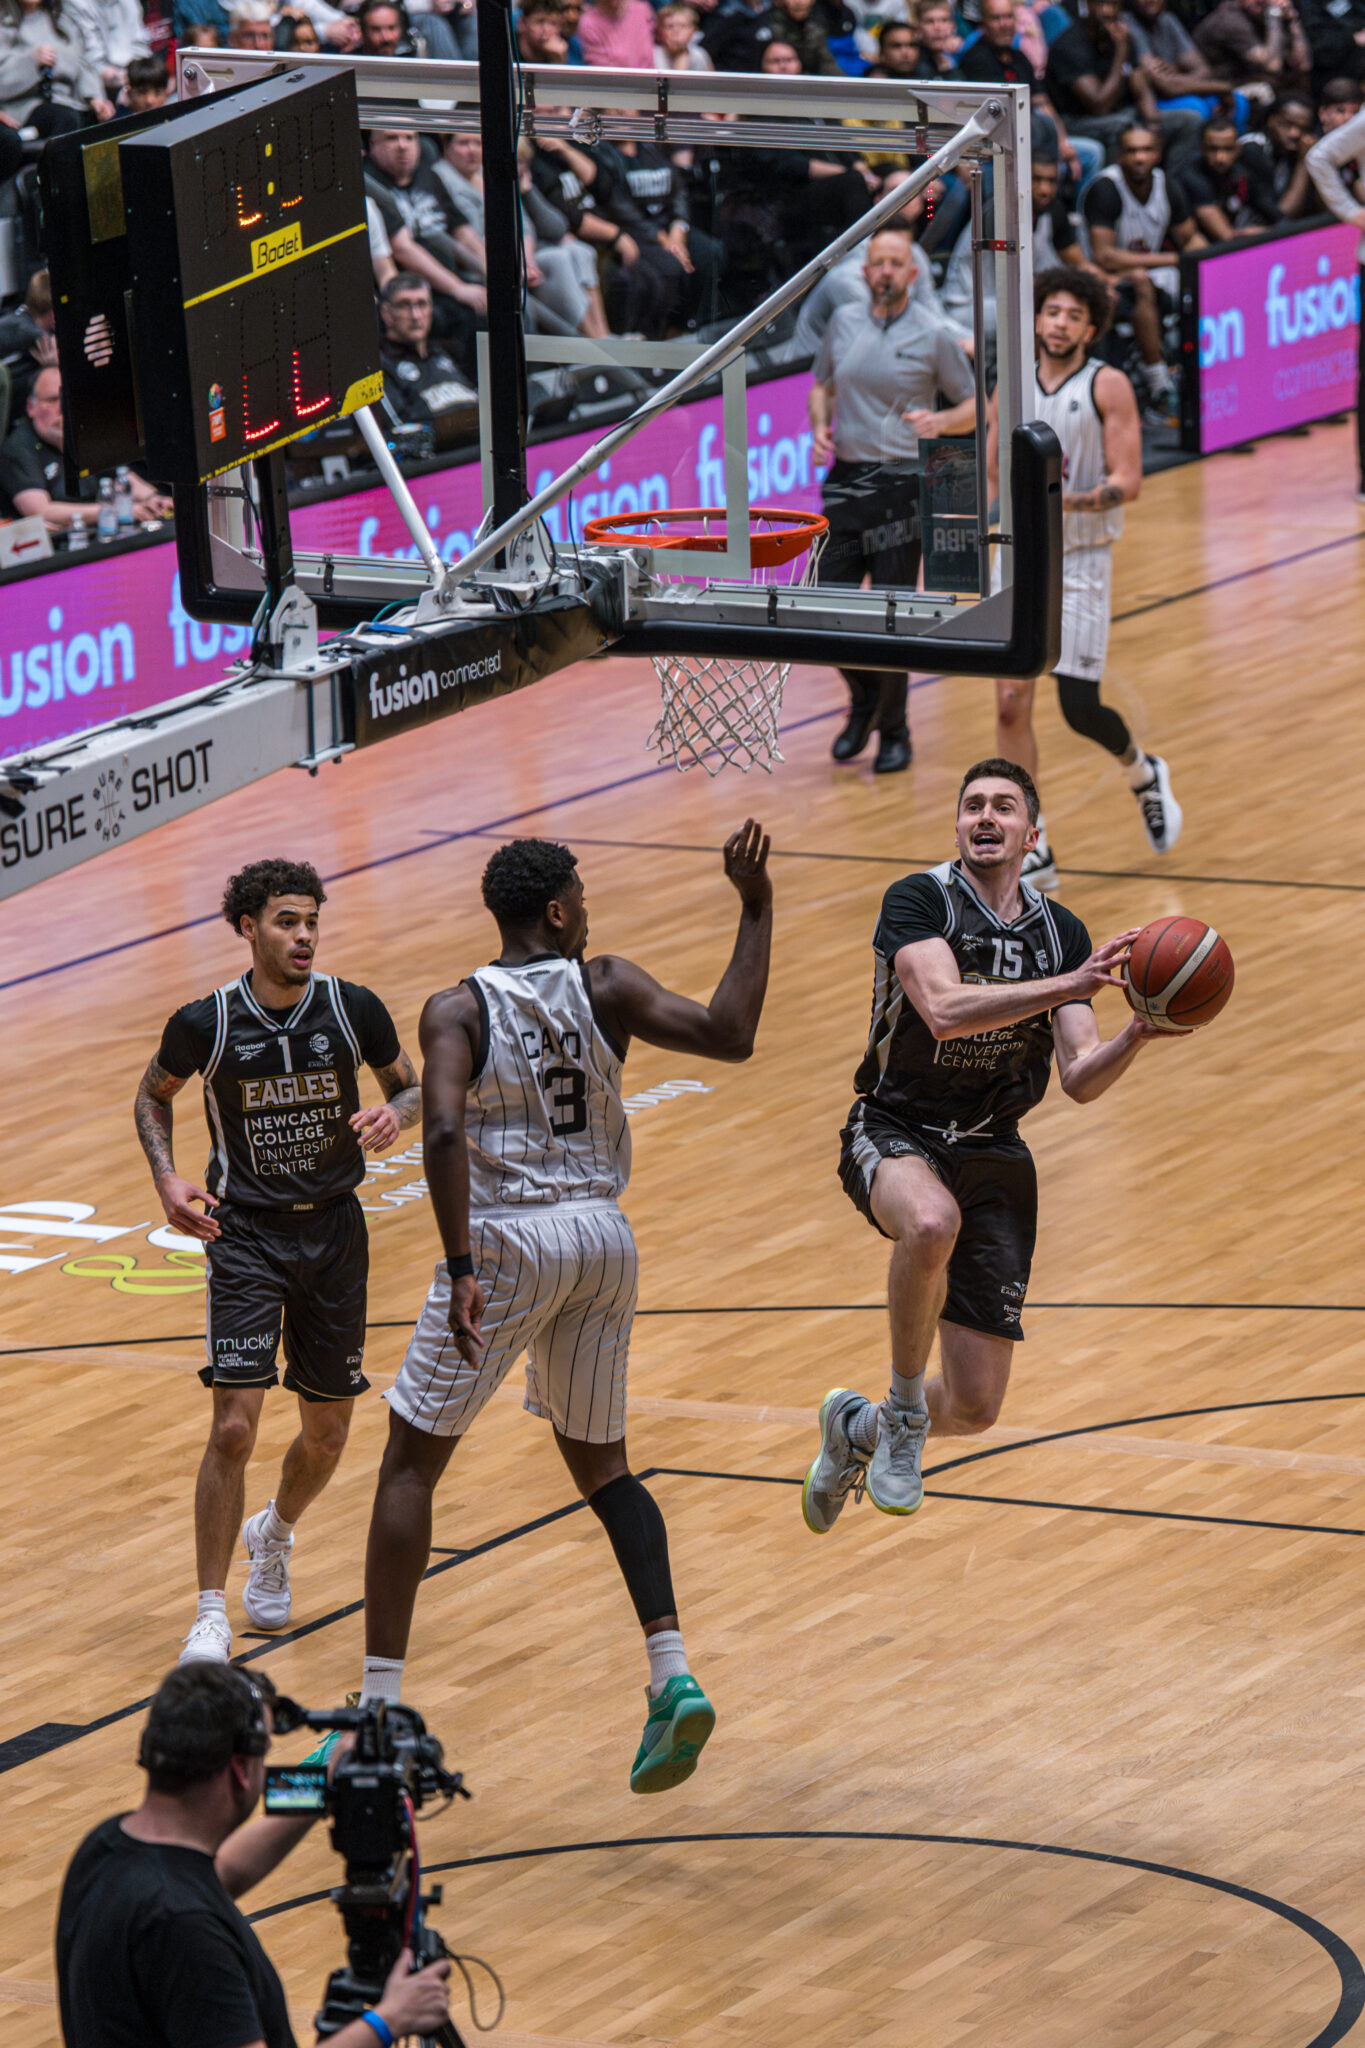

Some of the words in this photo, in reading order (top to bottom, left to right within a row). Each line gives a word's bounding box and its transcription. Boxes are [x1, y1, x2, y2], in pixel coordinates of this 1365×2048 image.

[256, 232, 299, 269] Bodet
[0, 605, 135, 717] usion
[369, 664, 438, 719] fusion
[440, 650, 502, 689] connected
[0, 794, 87, 868] SURE
[131, 739, 213, 812] SHOT
[992, 937, 1024, 979] 15
[235, 1041, 266, 1052] Reebok
[277, 1036, 293, 1073] 1
[941, 1054, 997, 1070] CENTRE
[243, 1072, 339, 1109] EAGLES
[250, 1105, 342, 1131] NEWCASTLE
[252, 1124, 325, 1146] COLLEGE
[256, 1135, 337, 1161] UNIVERSITY
[260, 1158, 317, 1176] CENTRE
